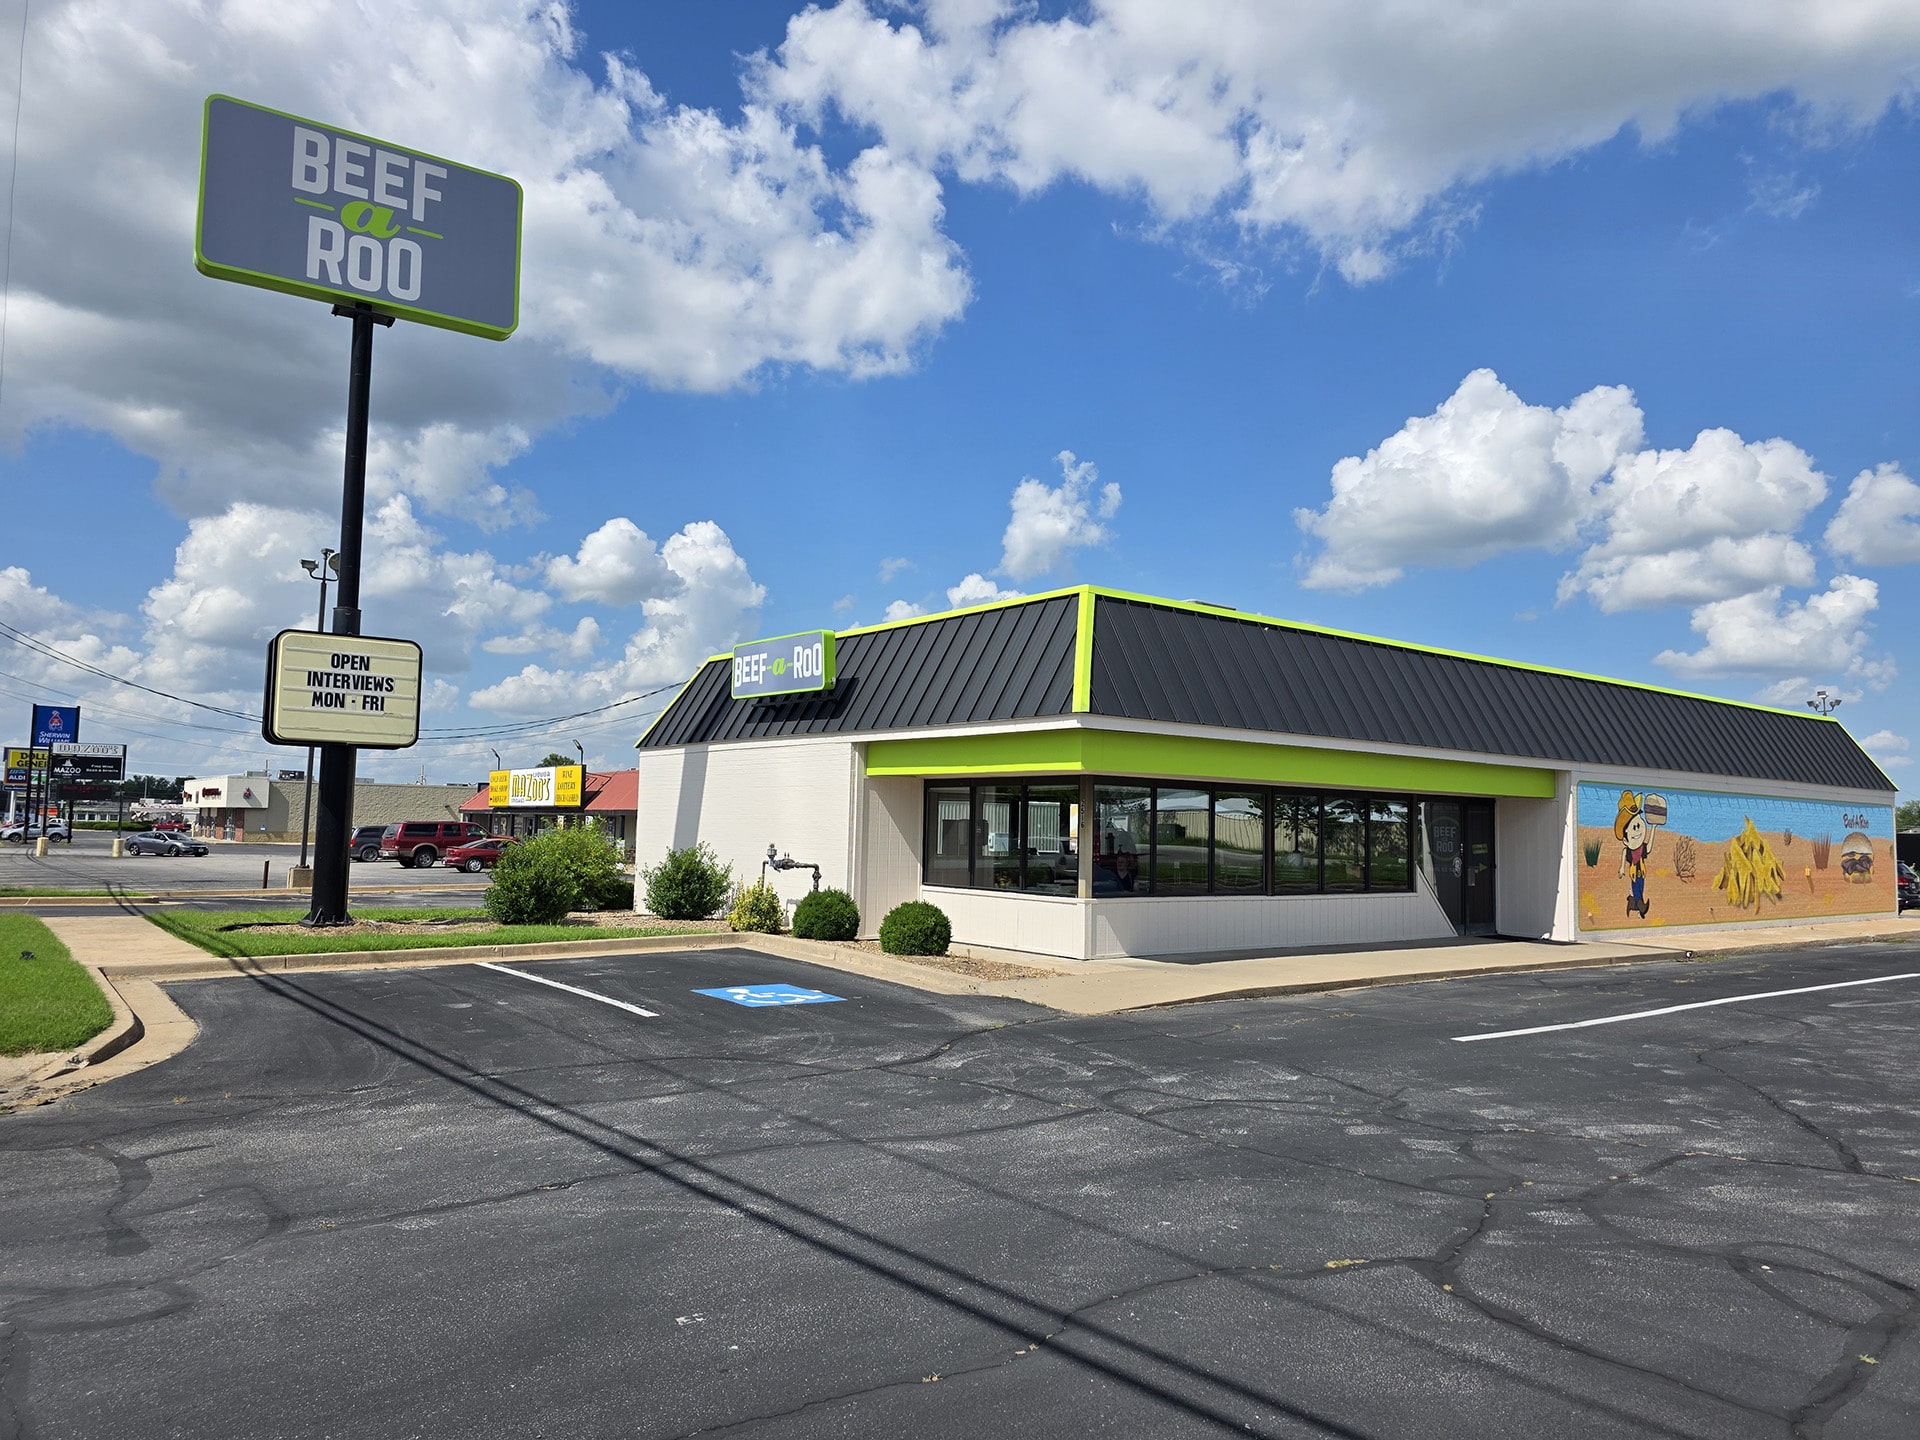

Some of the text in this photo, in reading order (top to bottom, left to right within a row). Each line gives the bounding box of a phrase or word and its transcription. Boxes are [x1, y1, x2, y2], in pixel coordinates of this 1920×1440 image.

[291, 125, 448, 222] BEEF
[340, 200, 401, 239] a
[306, 215, 423, 301] ROO
[330, 653, 370, 671] OPEN
[307, 671, 394, 692] INTERVIEWS
[311, 692, 345, 708] MON
[362, 694, 385, 711] FRI
[39, 731, 70, 739] SHERWIN
[21, 752, 48, 760] DOLL
[512, 774, 551, 801] MAZOO'S
[1434, 826, 1456, 837] BEEF
[1437, 841, 1453, 852] ROO
